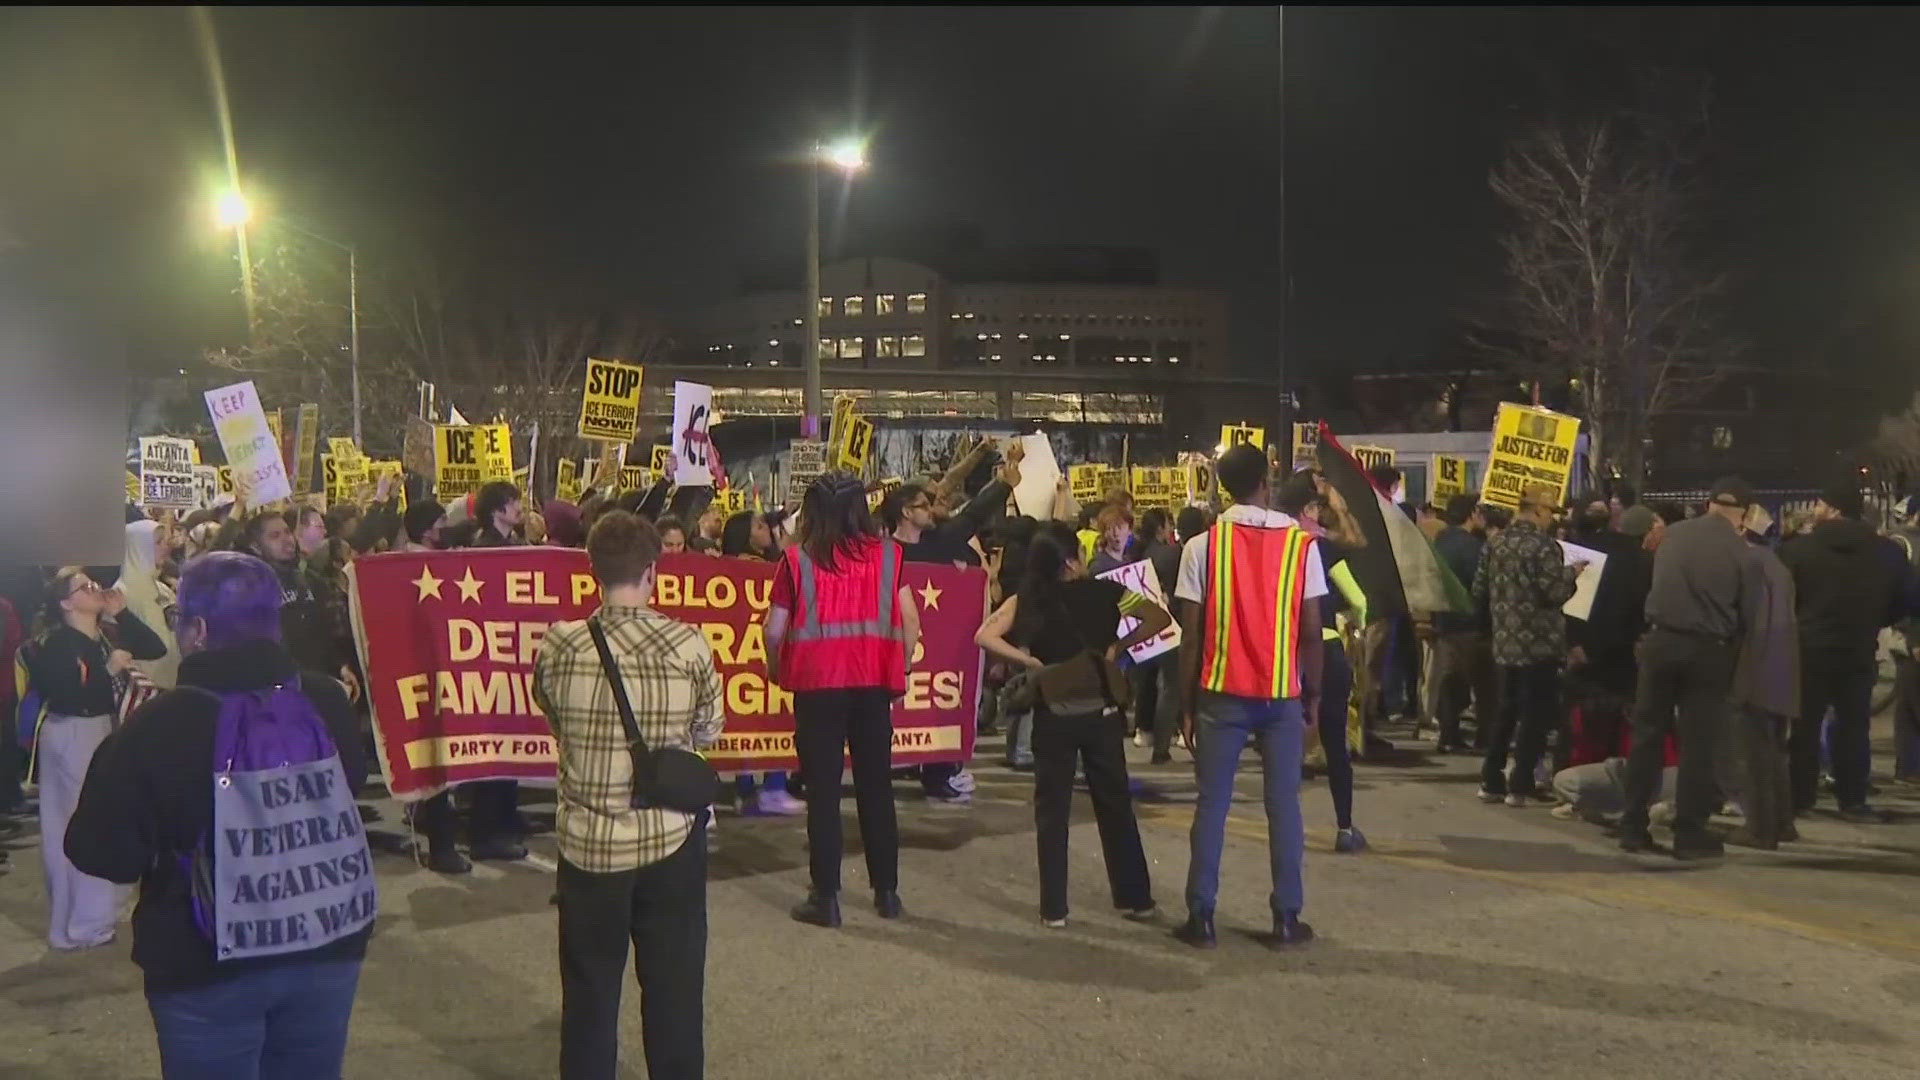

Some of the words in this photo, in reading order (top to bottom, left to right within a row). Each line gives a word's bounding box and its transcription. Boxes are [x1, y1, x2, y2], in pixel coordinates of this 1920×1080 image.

[589, 364, 640, 399] STOP
[210, 390, 245, 420] KEEP
[586, 401, 599, 416] ICE
[602, 402, 635, 420] TERROR
[584, 416, 634, 430] NOW!
[147, 444, 190, 461] ATLANTA
[446, 429, 476, 464] ICE
[1497, 435, 1546, 461] JUSTICE
[1545, 445, 1569, 466] FOR
[144, 474, 192, 484] STOP
[621, 468, 640, 488] STO
[1440, 456, 1459, 482] ICE
[506, 570, 559, 605] EL
[570, 573, 737, 608] PBLO
[450, 741, 504, 757] PARTY
[513, 740, 550, 754] FOR
[227, 912, 309, 948] THE
